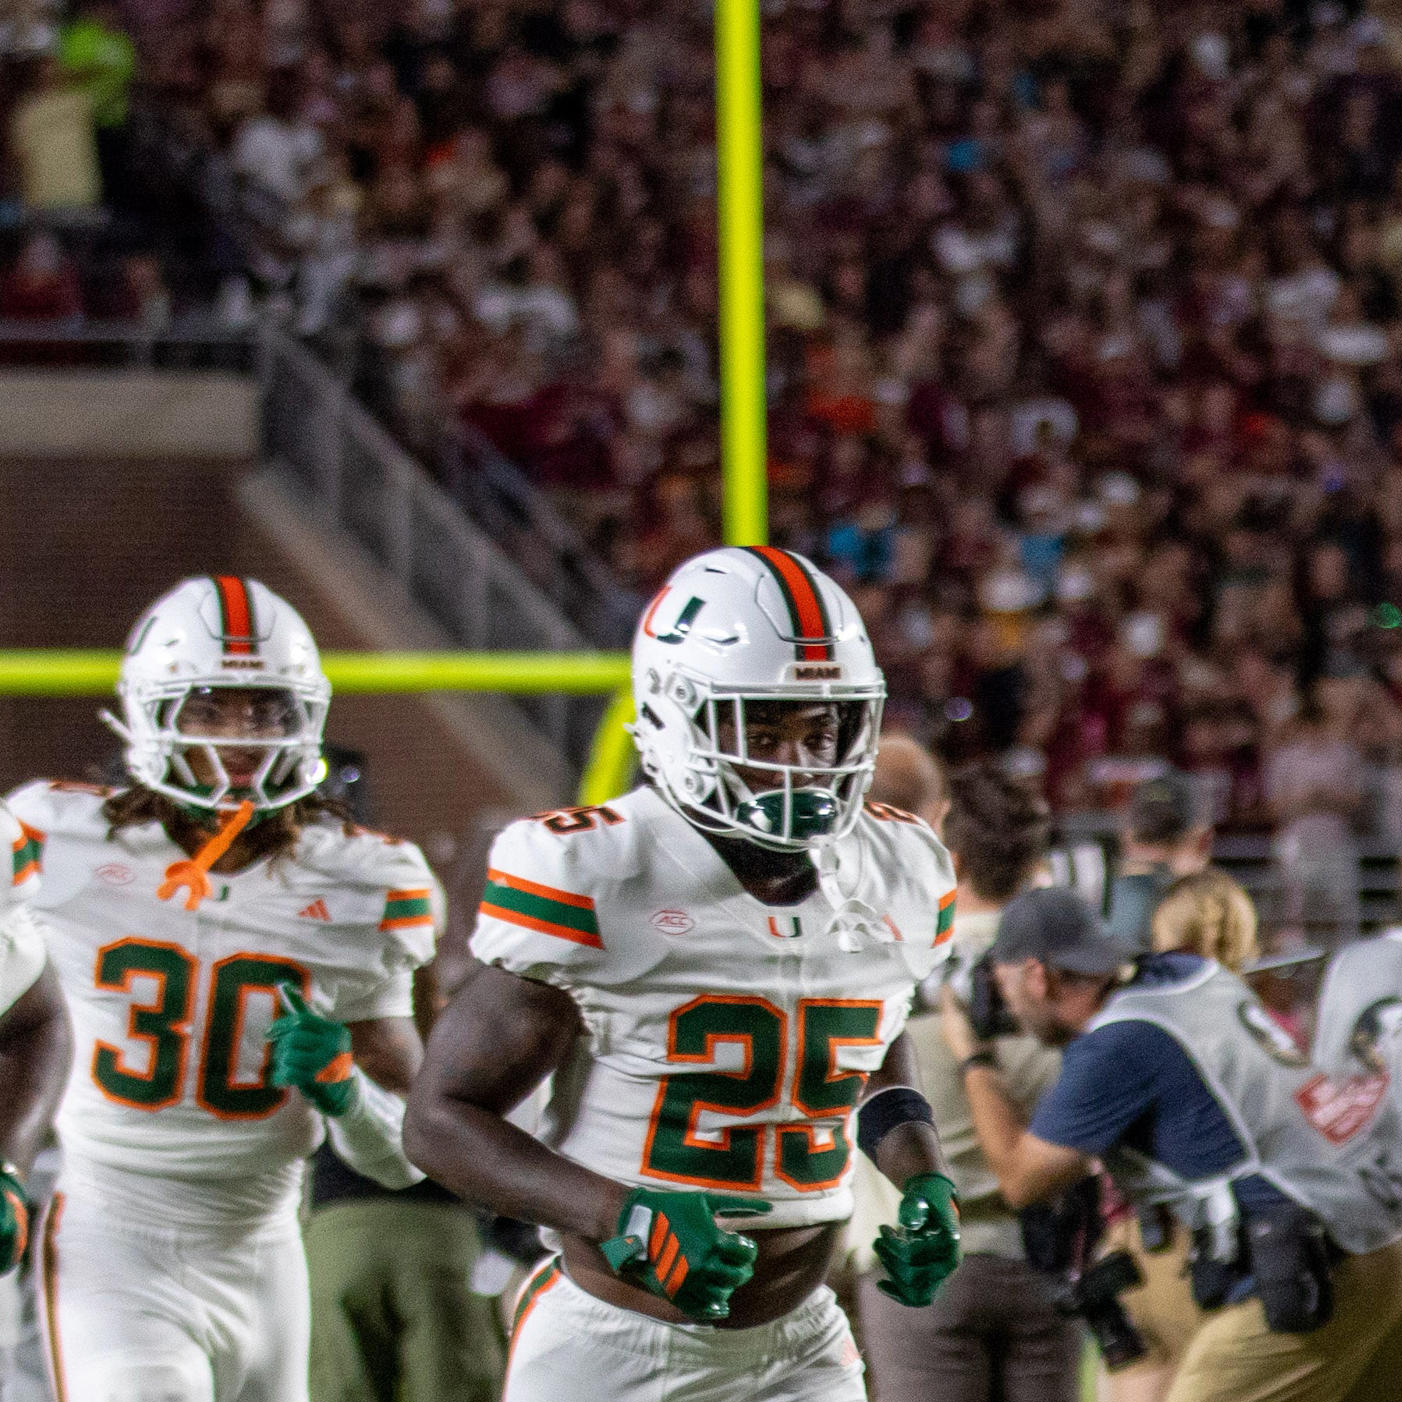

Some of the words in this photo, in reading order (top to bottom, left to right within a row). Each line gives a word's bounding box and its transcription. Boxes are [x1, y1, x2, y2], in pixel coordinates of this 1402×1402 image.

[644, 586, 707, 646] U
[795, 666, 841, 681] MIAMI
[767, 916, 800, 938] U
[91, 937, 311, 1122] 30
[641, 995, 885, 1194] 25
